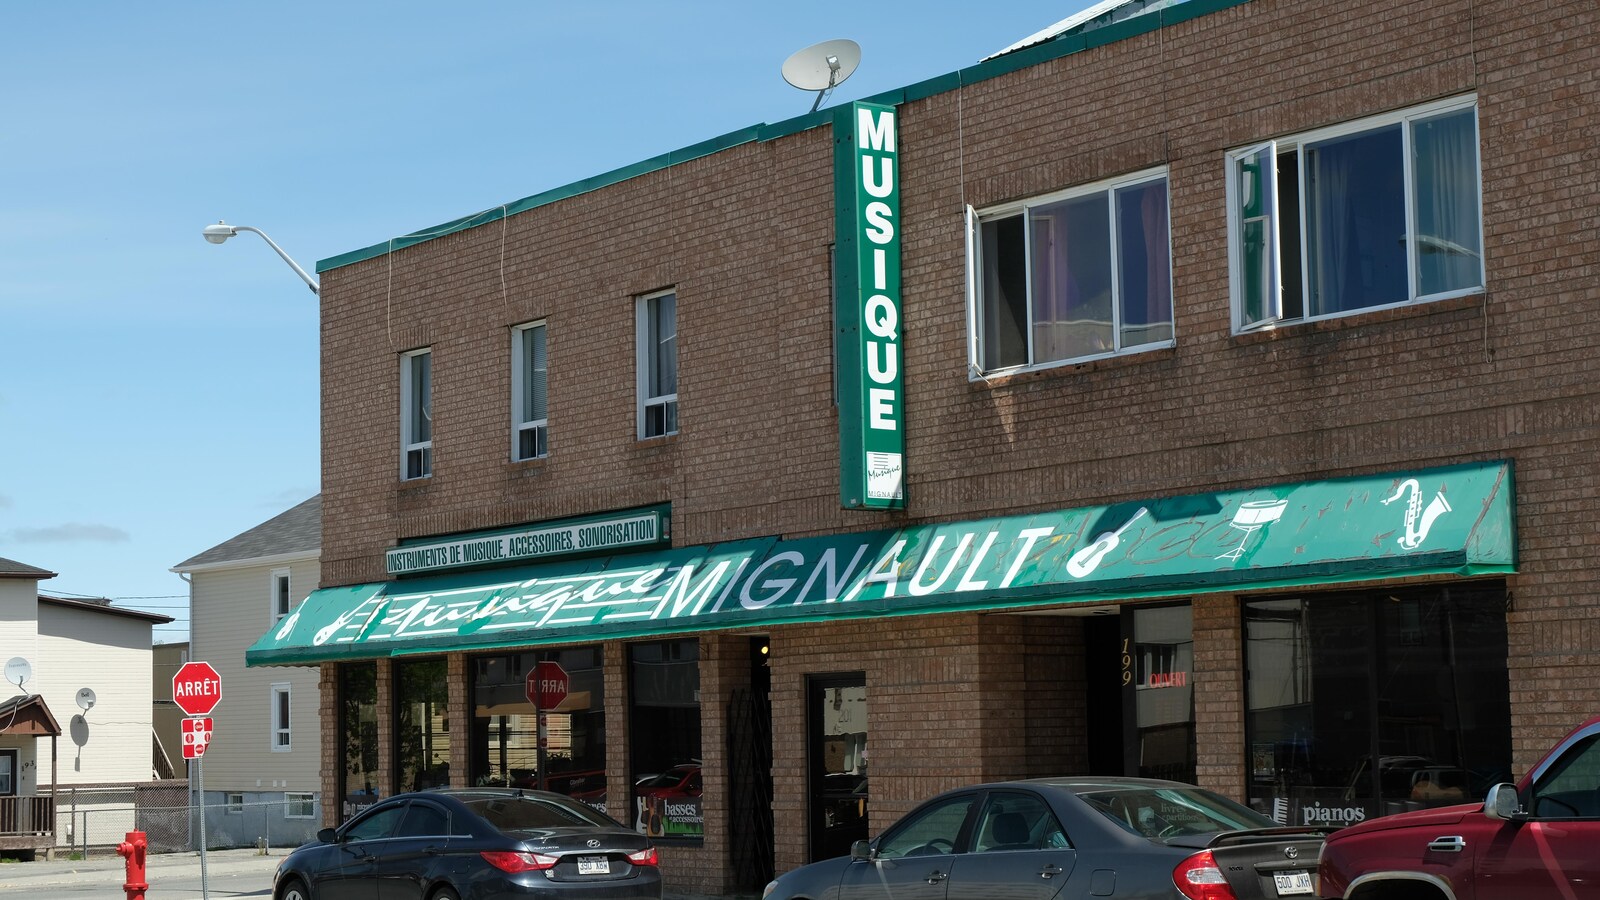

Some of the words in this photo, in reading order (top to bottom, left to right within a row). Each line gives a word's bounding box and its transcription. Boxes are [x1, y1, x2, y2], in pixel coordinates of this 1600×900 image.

[857, 108, 898, 430] MUSIQUE
[868, 465, 901, 481] Musique
[868, 490, 902, 499] MIGNAULT
[387, 546, 448, 571] INSTRUMENTS
[450, 544, 461, 564] DE
[463, 539, 507, 561] MUSIQUE,
[509, 530, 576, 556] ACCESSOIRES,
[578, 518, 655, 548] SONORISATION
[649, 526, 1054, 620] MIGNAULT
[353, 567, 675, 642] Musique
[1121, 638, 1132, 687] 199
[176, 678, 219, 697] ARRÊT
[1149, 671, 1187, 688] OUVERT
[664, 796, 697, 817] basses
[1161, 803, 1187, 814] livres
[1302, 801, 1366, 826] pianos
[1276, 876, 1293, 889] 500
[1296, 874, 1312, 888] JXH
